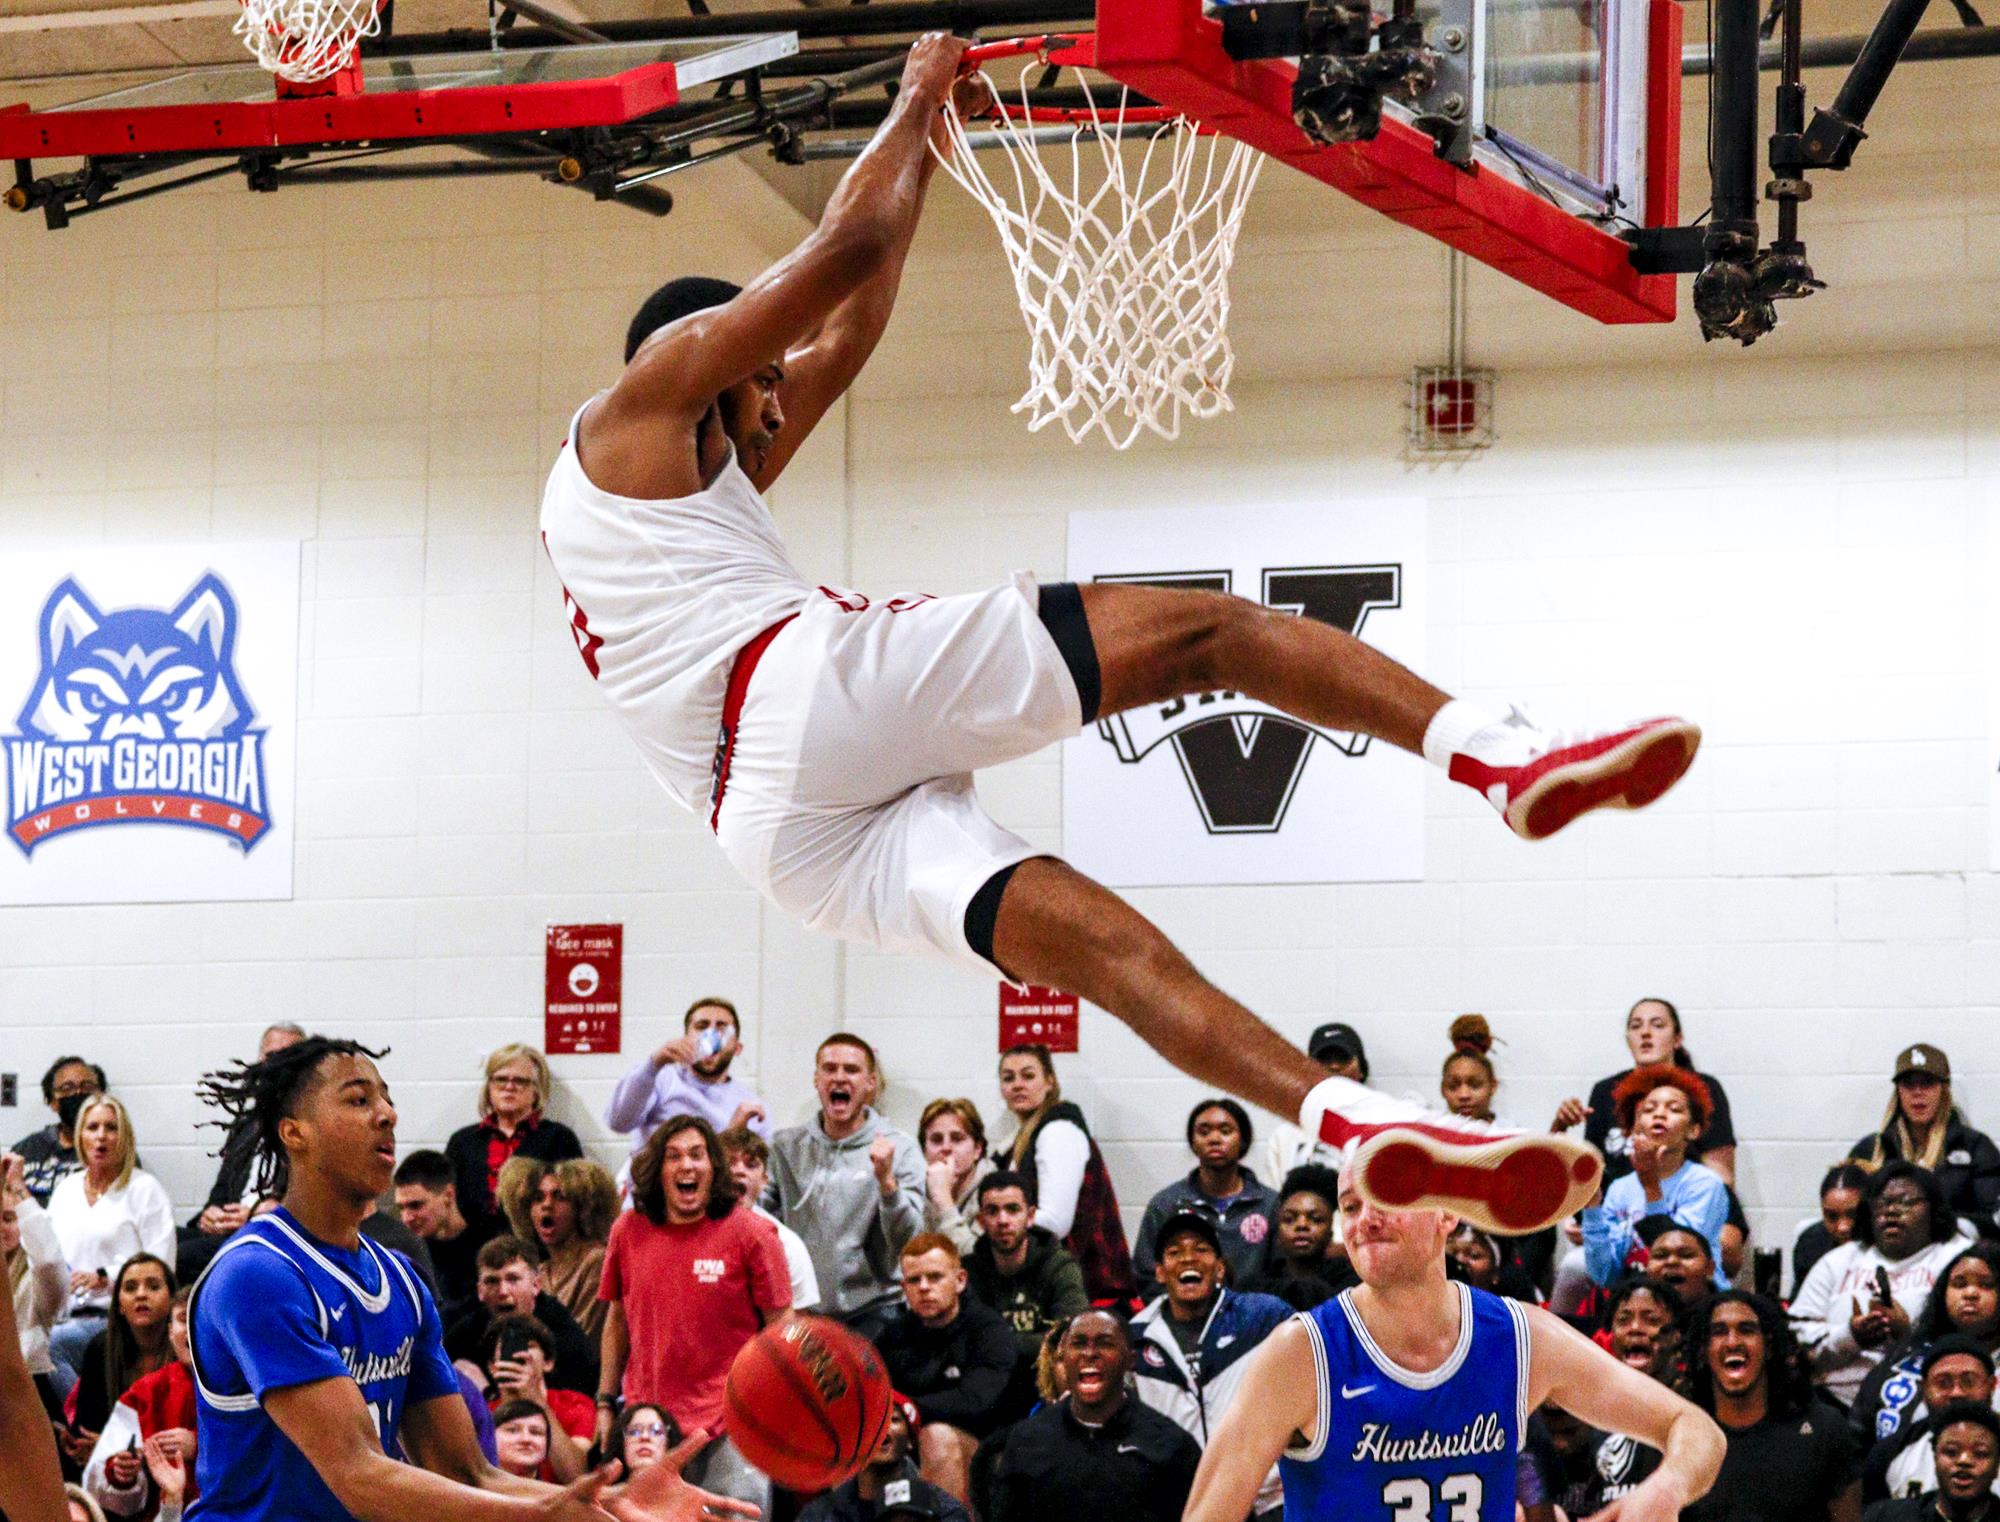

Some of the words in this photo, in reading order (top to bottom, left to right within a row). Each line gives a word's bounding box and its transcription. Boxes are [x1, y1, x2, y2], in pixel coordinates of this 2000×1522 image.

[10, 740, 110, 821] WEST
[113, 736, 262, 813] GEORGIA
[34, 799, 242, 832] WOLVES
[583, 937, 614, 950] mask
[1353, 1412, 1506, 1462] Huntsville
[1383, 1473, 1483, 1522] 33
